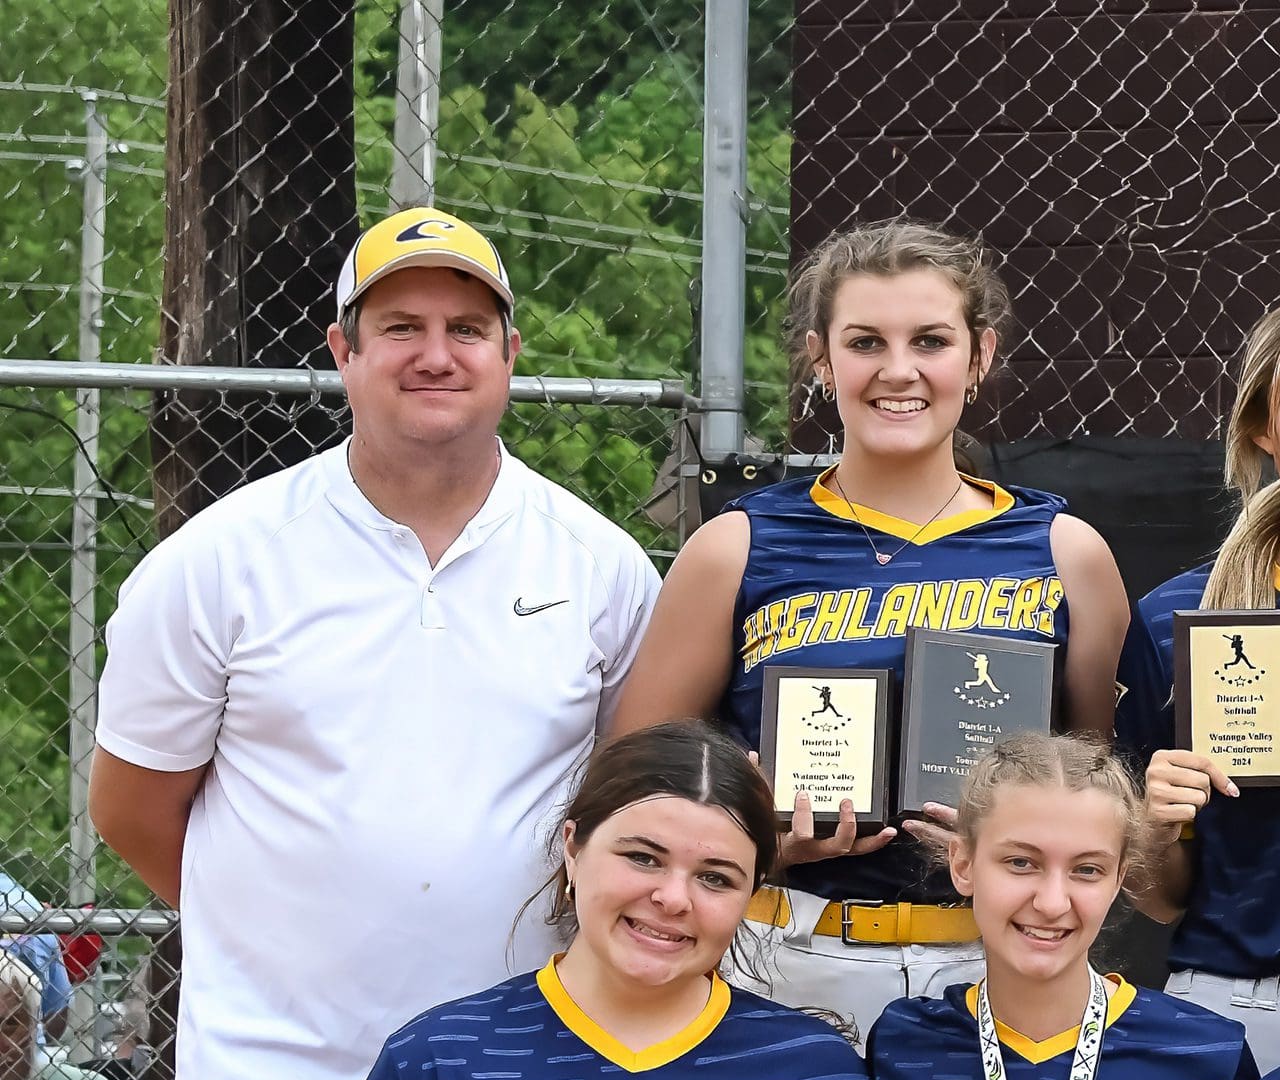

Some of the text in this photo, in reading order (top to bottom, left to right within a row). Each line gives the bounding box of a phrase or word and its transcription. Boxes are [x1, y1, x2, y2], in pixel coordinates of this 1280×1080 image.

[1216, 694, 1248, 703] District
[1224, 706, 1257, 715] Softball
[958, 720, 987, 732] District
[1248, 732, 1274, 742] Valley
[801, 738, 833, 747] District
[1210, 745, 1274, 754] All-Conference
[921, 763, 948, 774] MOST
